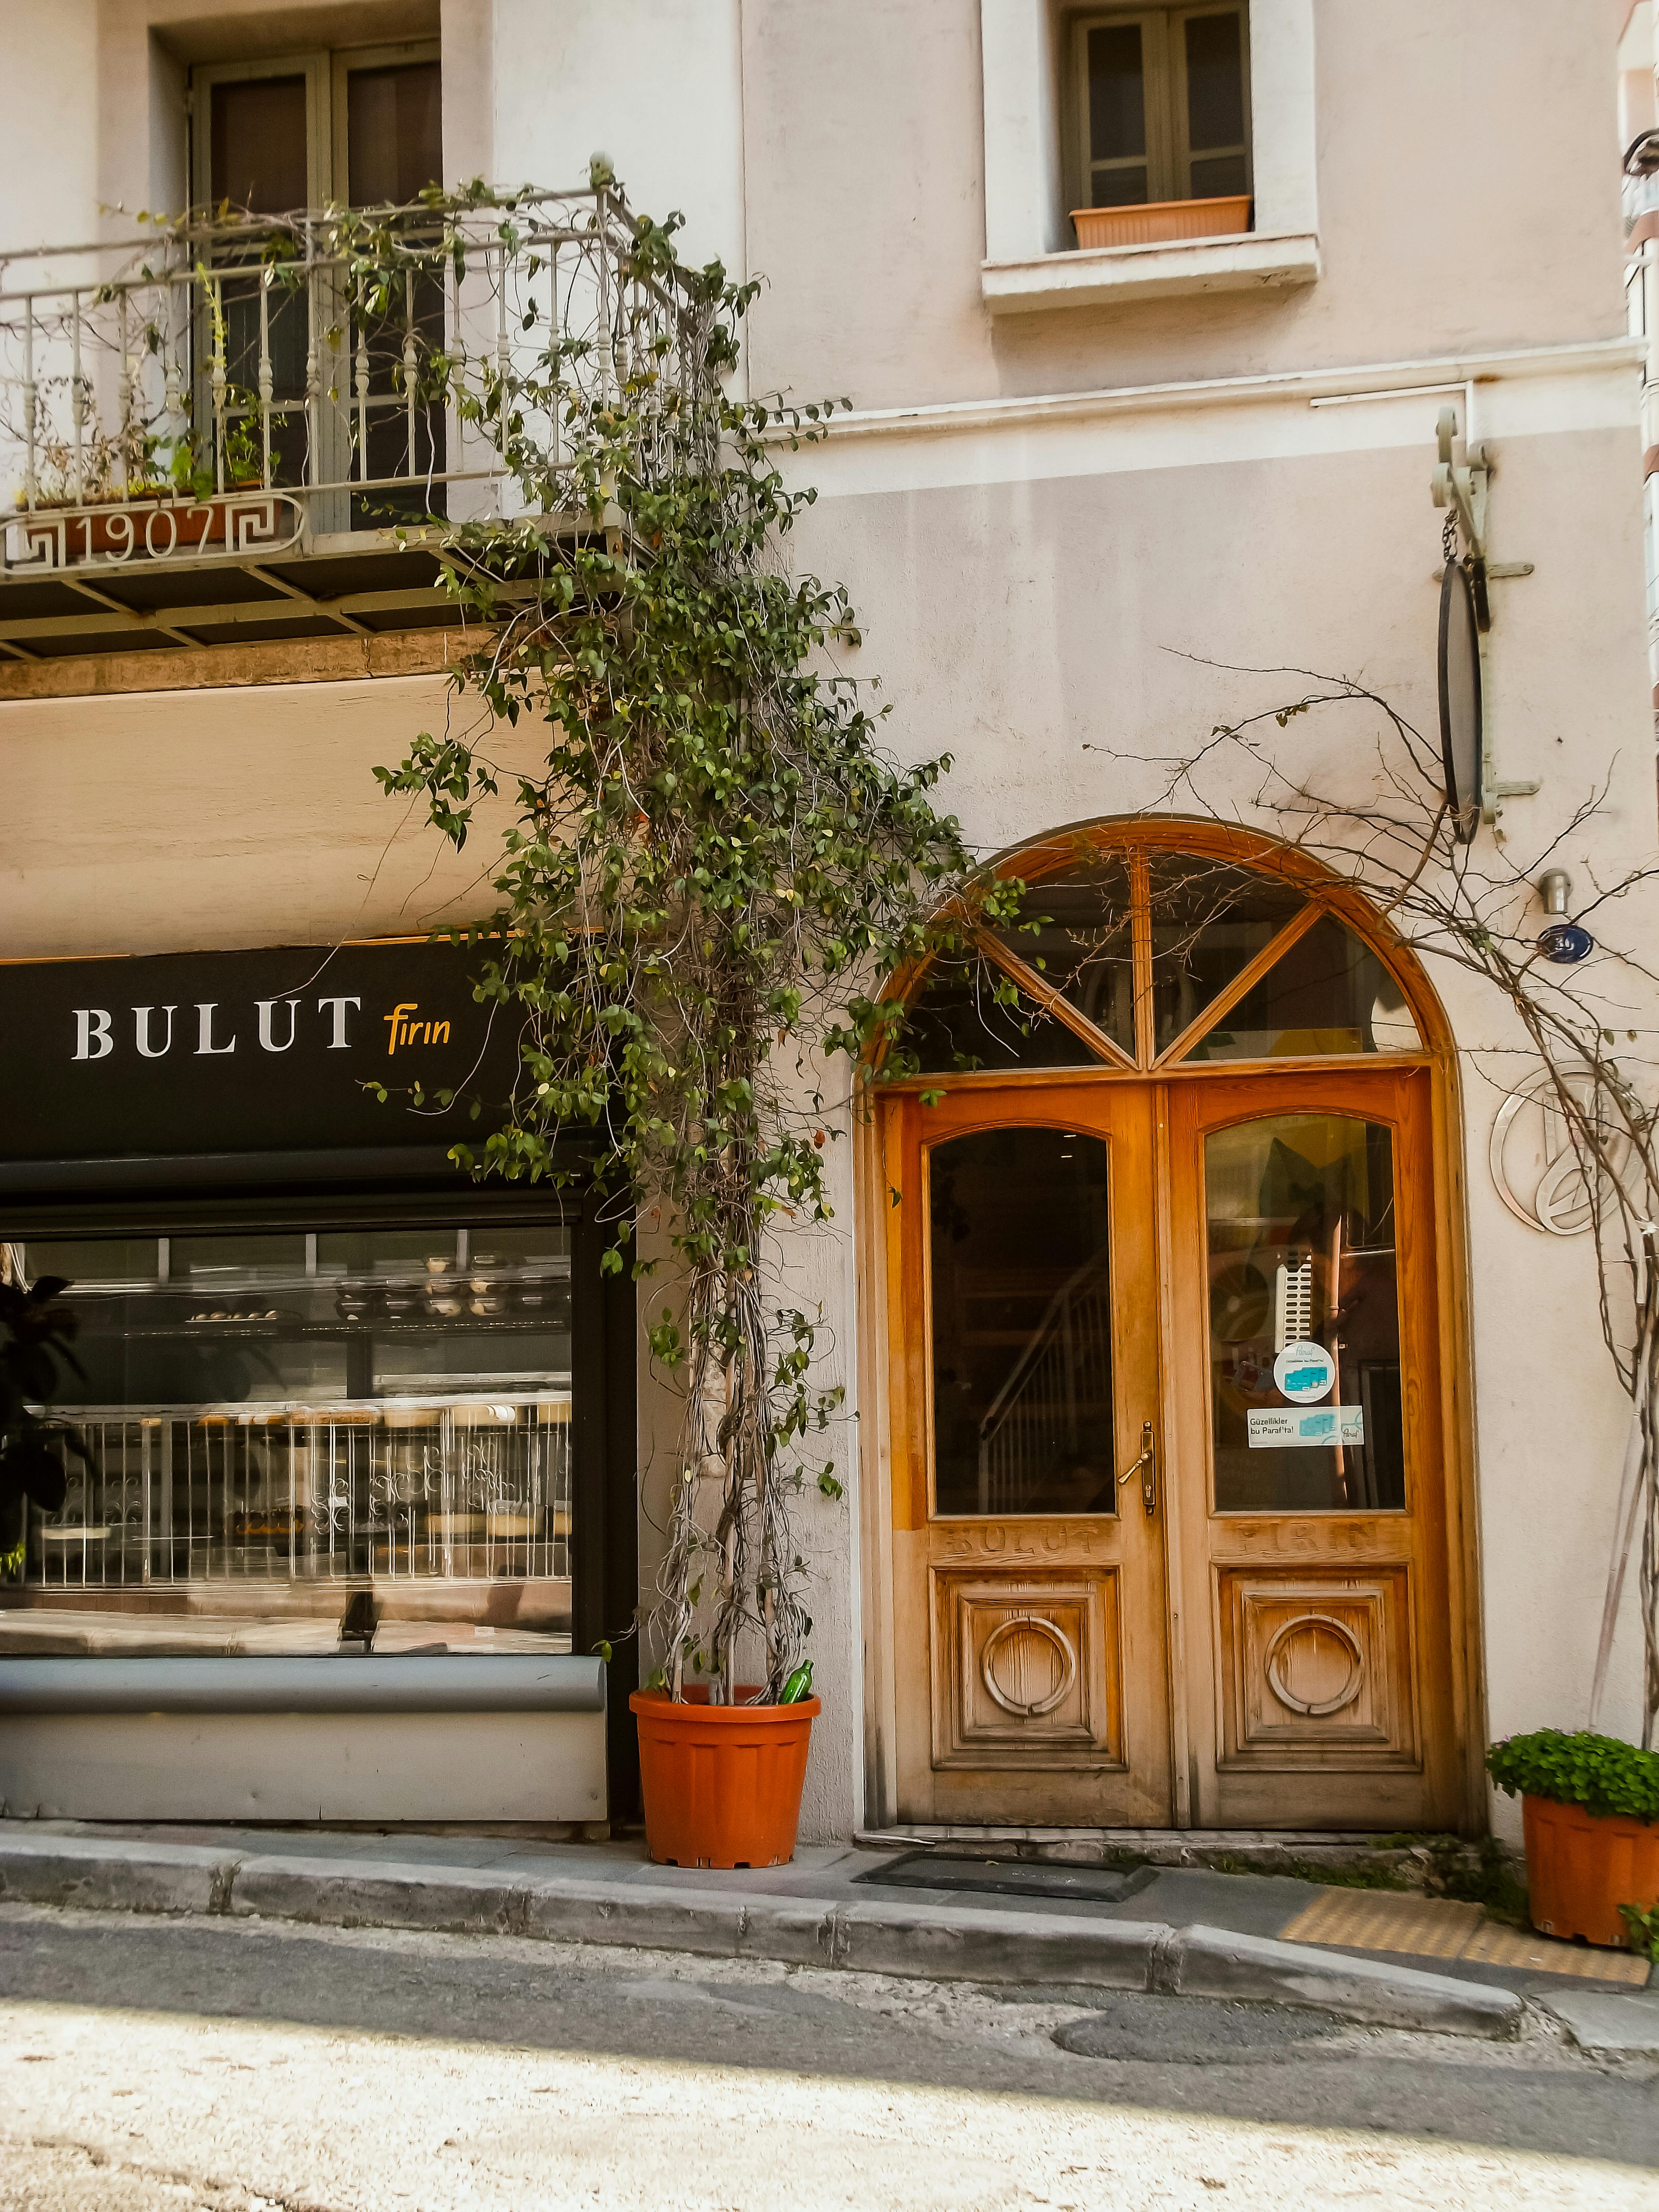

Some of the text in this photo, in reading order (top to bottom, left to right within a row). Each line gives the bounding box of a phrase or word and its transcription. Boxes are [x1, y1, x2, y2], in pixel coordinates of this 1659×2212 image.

[76, 506, 215, 565] 1907
[71, 997, 361, 1060] BULUT
[1262, 1426, 1294, 1434] Paraf'ta!
[946, 1524, 1099, 1554] BULUT
